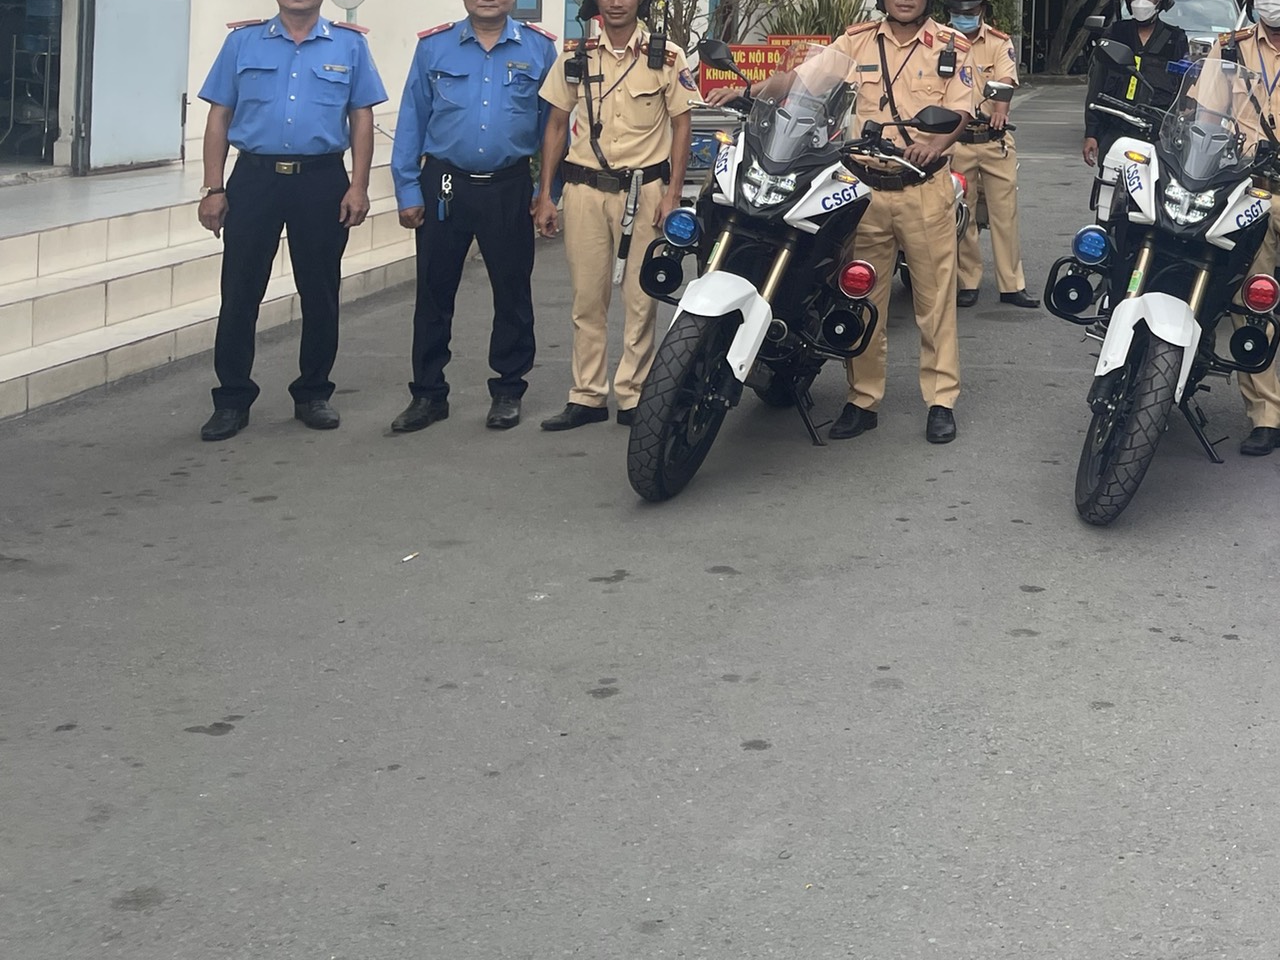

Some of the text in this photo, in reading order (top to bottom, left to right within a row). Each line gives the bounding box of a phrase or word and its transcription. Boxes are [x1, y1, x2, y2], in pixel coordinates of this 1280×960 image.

[749, 49, 764, 65] NỘI
[768, 50, 780, 65] BỘ
[1126, 163, 1143, 194] CSGT
[821, 180, 860, 211] CSGT
[1236, 200, 1264, 229] CSGT
